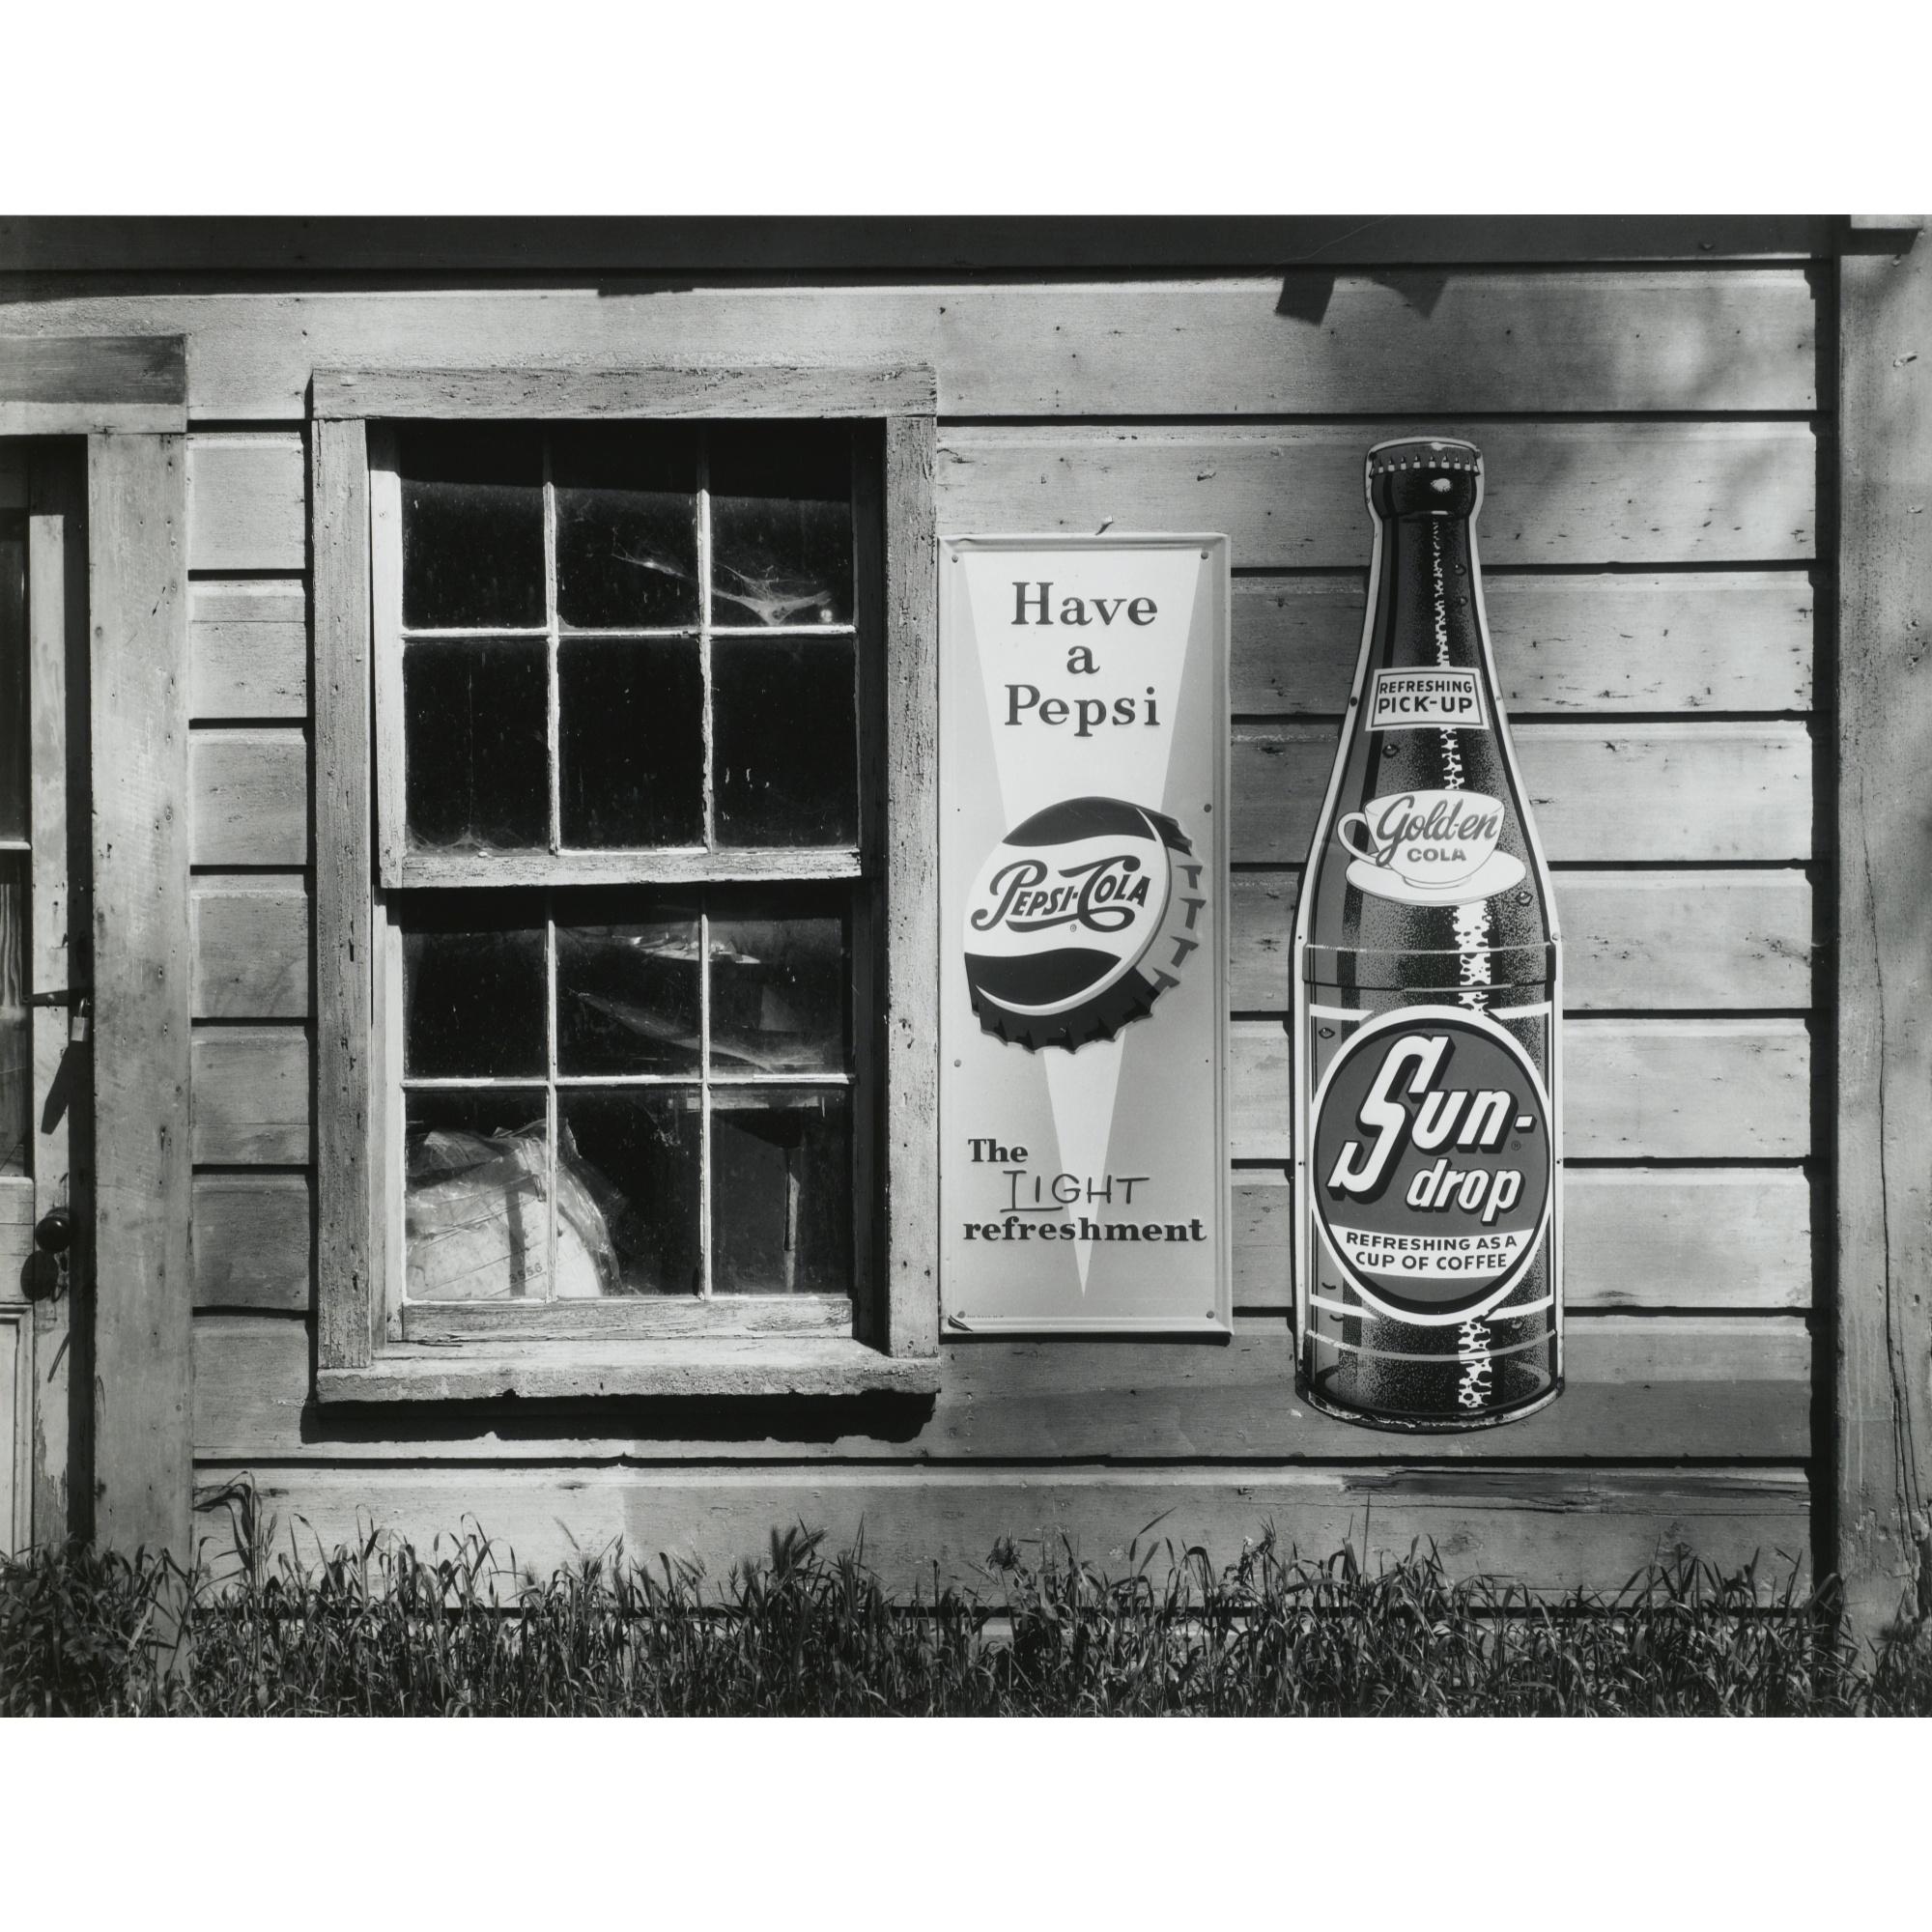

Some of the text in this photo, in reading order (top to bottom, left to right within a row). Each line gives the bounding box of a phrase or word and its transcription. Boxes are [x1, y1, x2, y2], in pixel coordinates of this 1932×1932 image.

[1010, 582, 1157, 626] Have
[1065, 645, 1100, 674] a
[1379, 680, 1472, 695] REFRESHING
[1004, 684, 1161, 737] Pepsi
[1378, 696, 1473, 714] PICK-UP
[1406, 847, 1467, 863] COLA
[968, 1138, 1029, 1163] The
[1405, 1157, 1526, 1228] drop
[963, 1216, 1207, 1242] refreshment
[1346, 1232, 1518, 1252] REFRESHING AS A
[1355, 1251, 1507, 1271] CUP OF COFFEE
